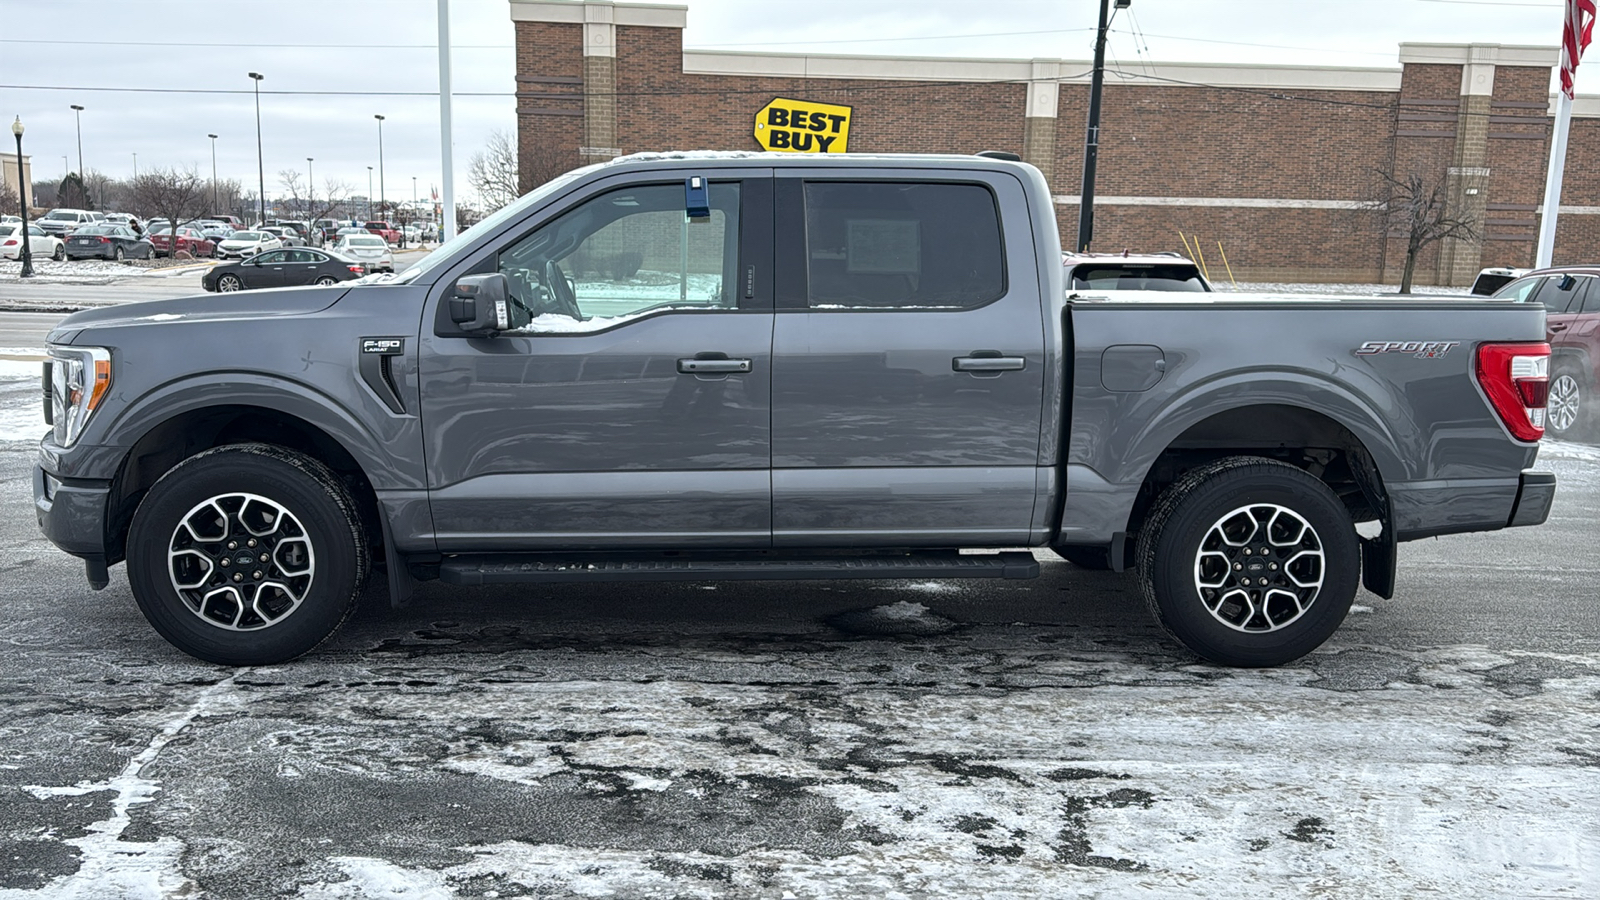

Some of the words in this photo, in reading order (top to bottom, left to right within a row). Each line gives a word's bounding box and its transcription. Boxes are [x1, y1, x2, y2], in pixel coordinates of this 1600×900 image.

[768, 107, 846, 133] BEST
[769, 129, 837, 153] BUY
[364, 340, 400, 348] F-150
[1355, 340, 1460, 355] SPORT
